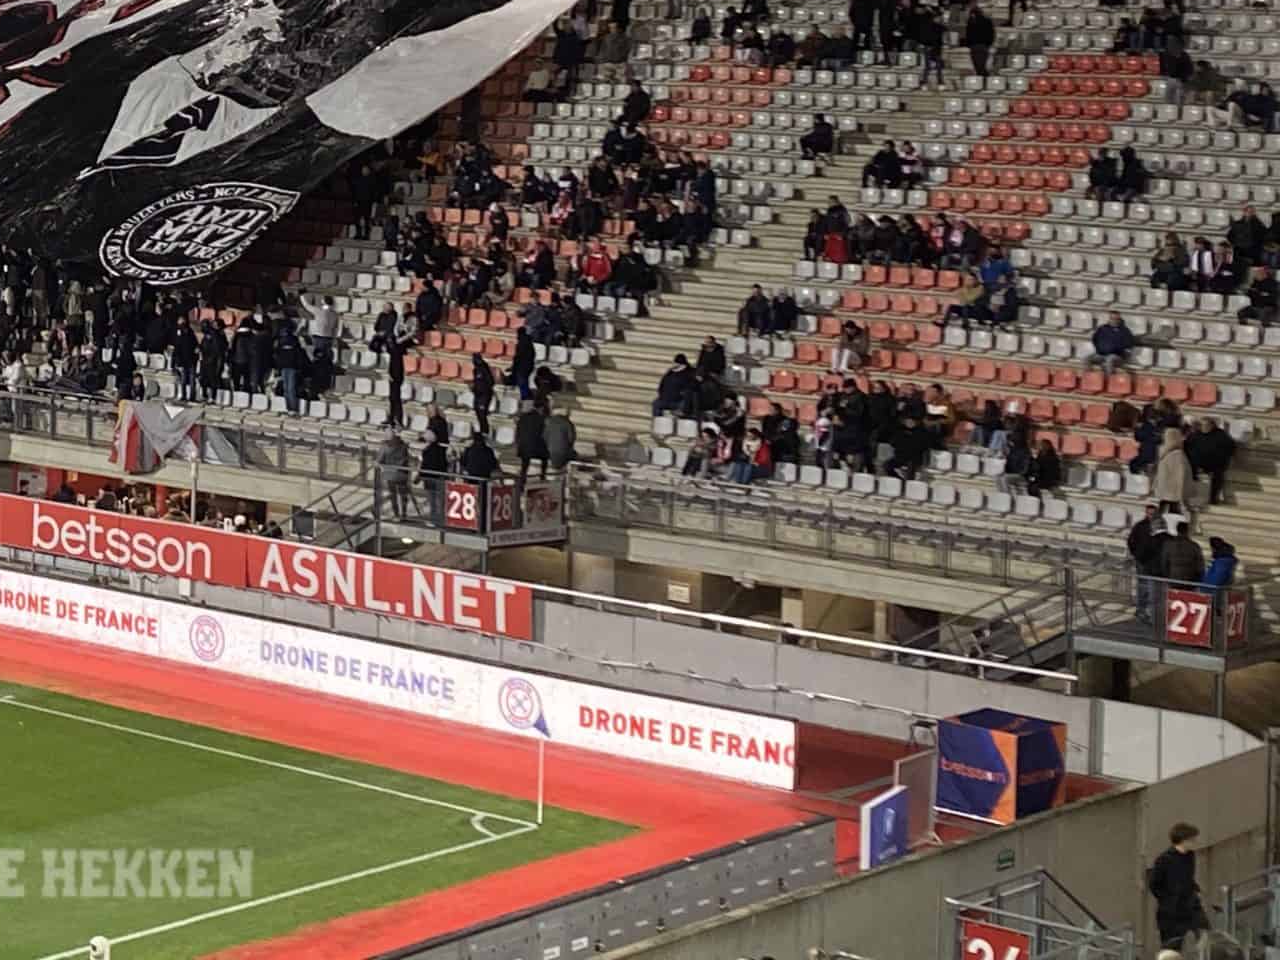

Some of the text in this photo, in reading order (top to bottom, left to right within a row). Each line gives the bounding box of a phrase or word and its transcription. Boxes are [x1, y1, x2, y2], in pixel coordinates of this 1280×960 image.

[170, 204, 269, 230] ANTI
[448, 490, 476, 520] 28
[492, 493, 512, 521] 28
[32, 503, 212, 579] betsson
[259, 542, 516, 633] ASNL.NET
[55, 598, 79, 622] DE
[83, 605, 158, 638] FRANCE
[1169, 601, 1209, 636] 27
[1228, 601, 1246, 636] 27
[260, 640, 455, 701] DRONE DE FRANCE
[579, 704, 662, 743] DRONE
[670, 722, 703, 751] DE
